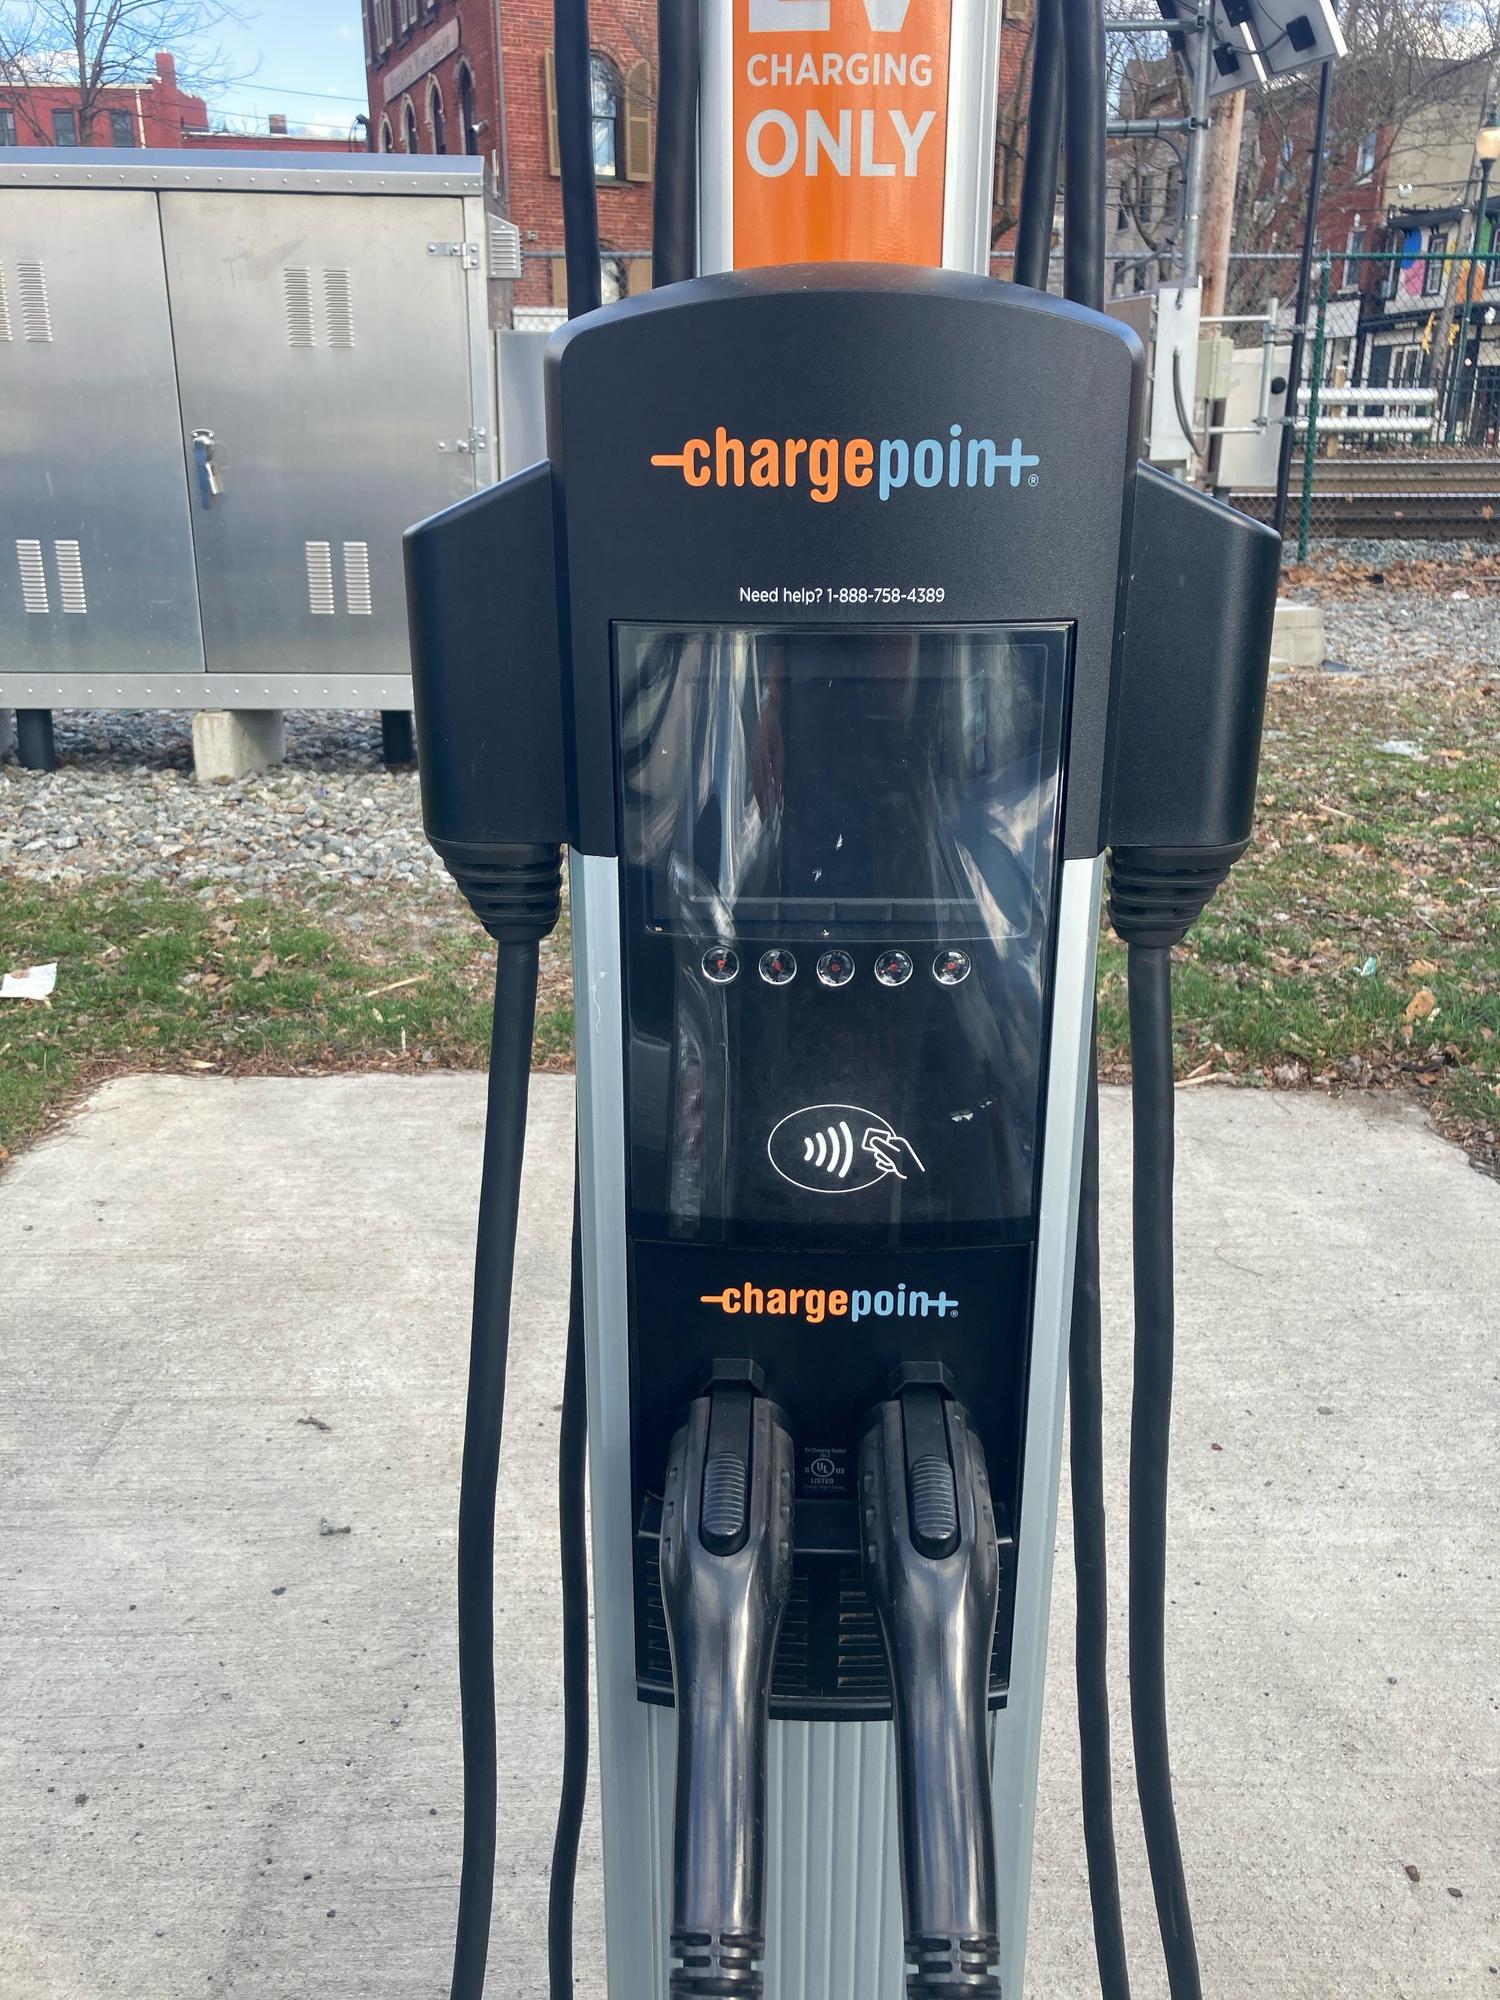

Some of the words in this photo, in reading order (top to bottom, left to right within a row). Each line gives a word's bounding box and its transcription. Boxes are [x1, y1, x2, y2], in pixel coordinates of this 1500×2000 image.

[746, 53, 933, 87] CHARGING
[745, 108, 937, 178] ONLY
[739, 587, 779, 603] Need
[783, 587, 823, 605] help?
[827, 587, 946, 603] 1-888-758-4389
